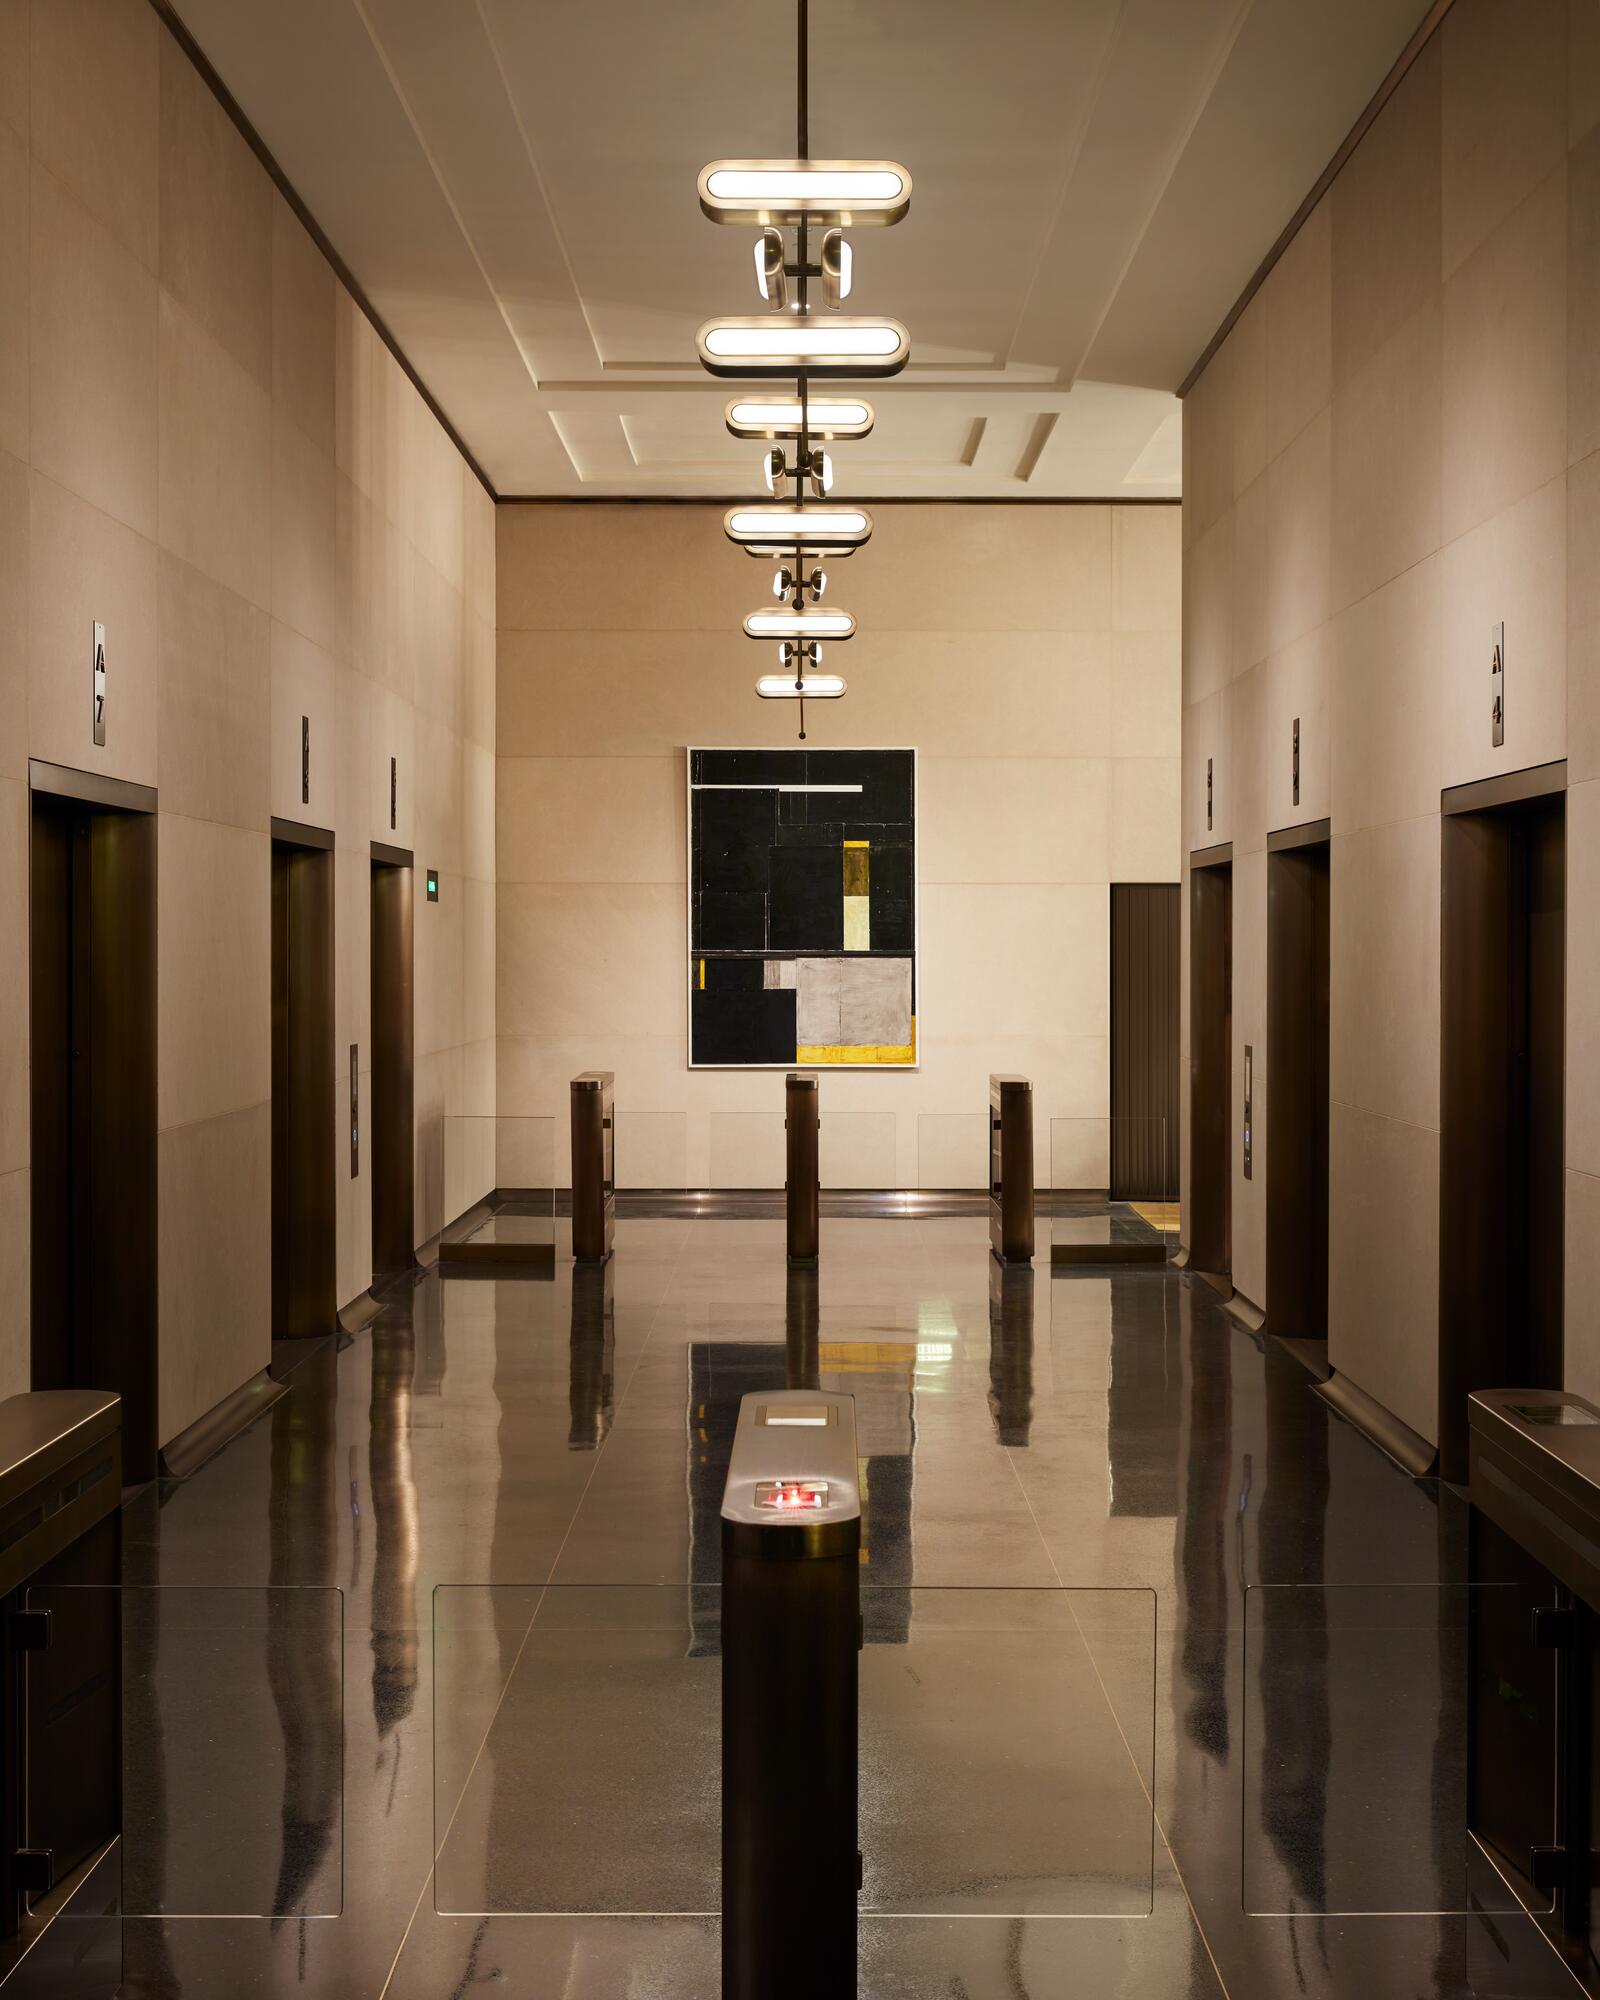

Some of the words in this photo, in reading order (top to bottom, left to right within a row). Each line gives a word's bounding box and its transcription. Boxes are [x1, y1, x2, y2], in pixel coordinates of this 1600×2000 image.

[96, 643, 105, 673] A
[1492, 644, 1501, 674] A
[96, 694, 104, 723] 7
[1492, 695, 1501, 723] 4
